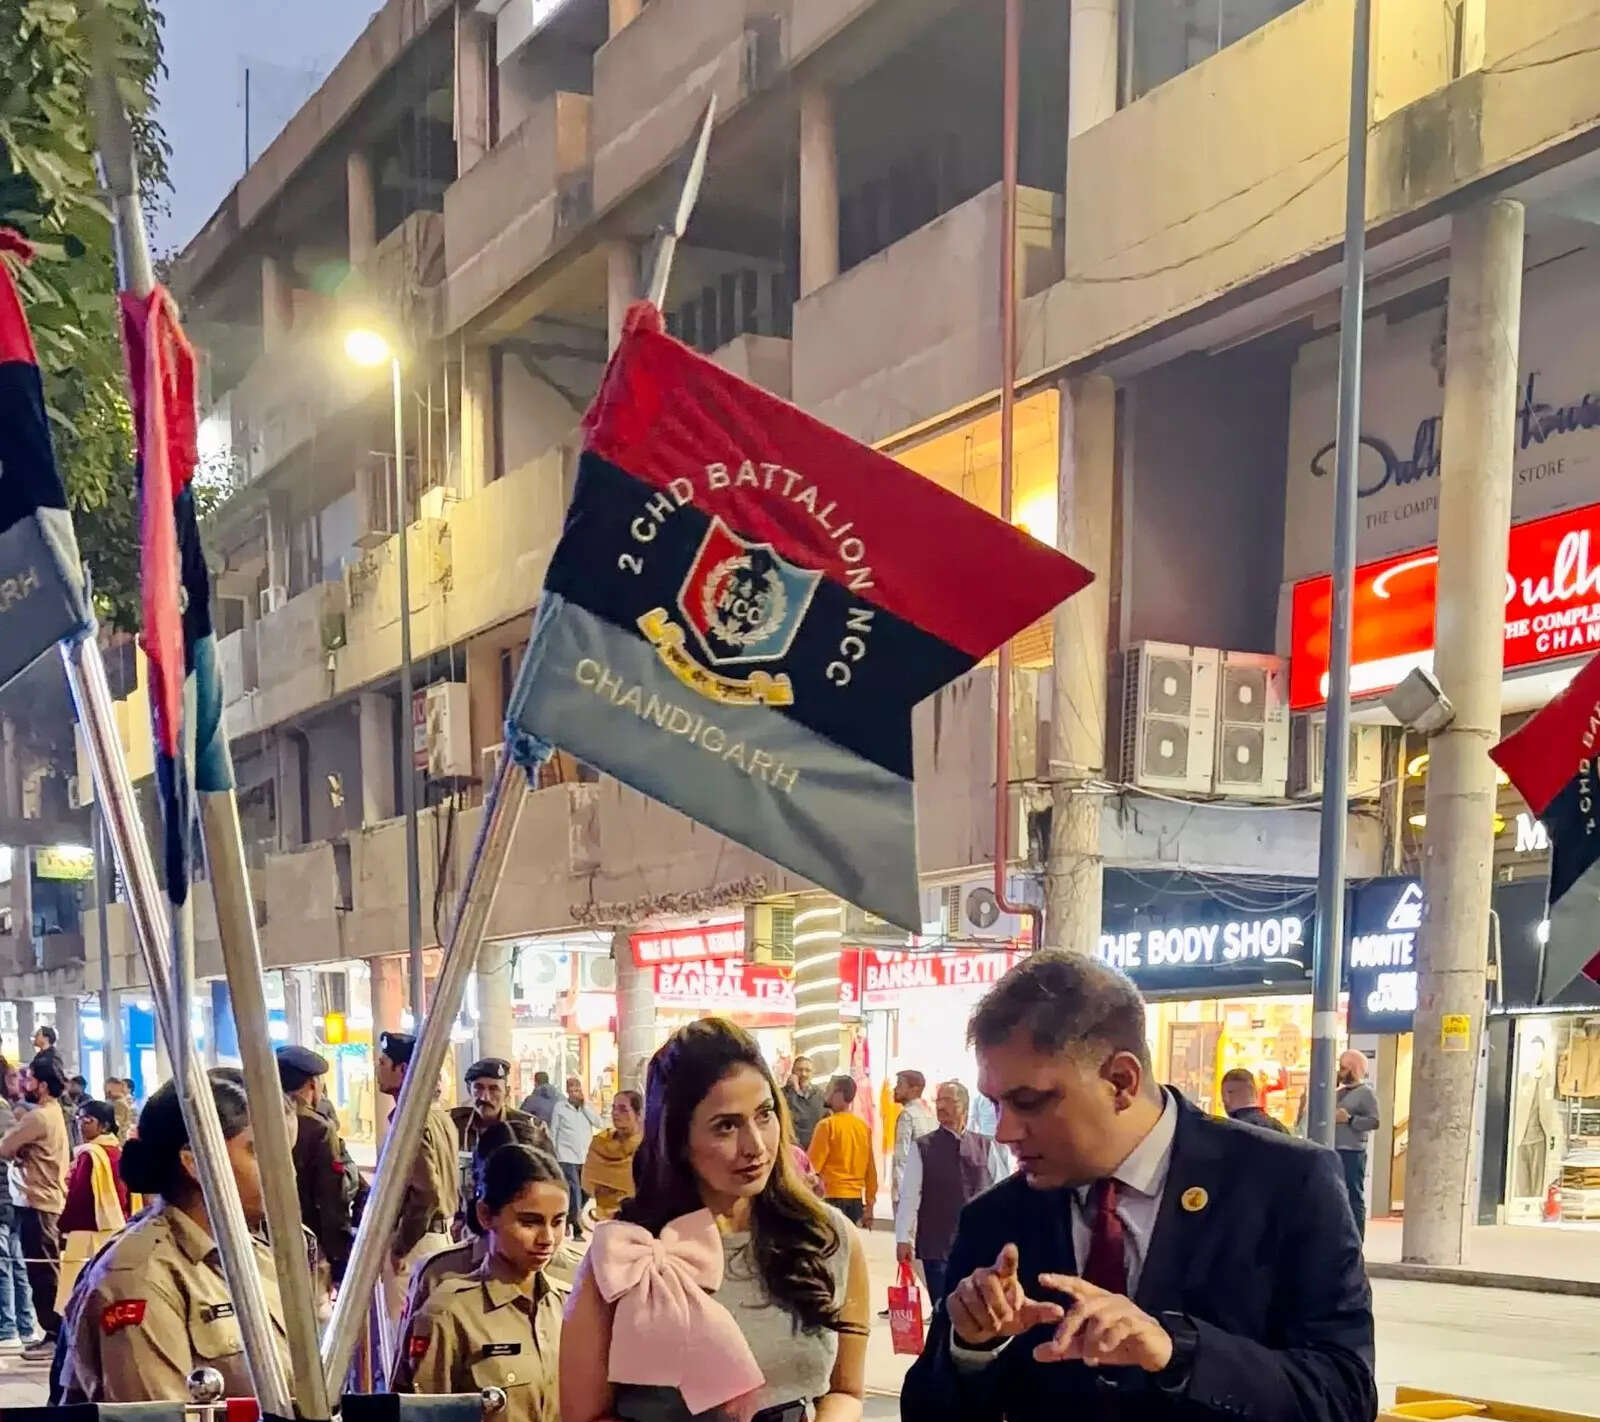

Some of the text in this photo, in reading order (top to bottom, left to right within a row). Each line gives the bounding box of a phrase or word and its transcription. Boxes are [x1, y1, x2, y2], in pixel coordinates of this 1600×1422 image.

[630, 477, 695, 543] CHD
[1366, 509, 1390, 529] THE
[1518, 458, 1566, 485] STORE
[705, 459, 875, 591] BATTALION
[617, 552, 645, 576] 2
[825, 606, 874, 688] NCC
[575, 657, 800, 794] CHANDIGARH
[1579, 758, 1592, 813] CHD
[1098, 916, 1303, 968] THE BODY SHOP
[659, 974, 748, 998] BANSAL
[867, 960, 938, 989] BANSAL
